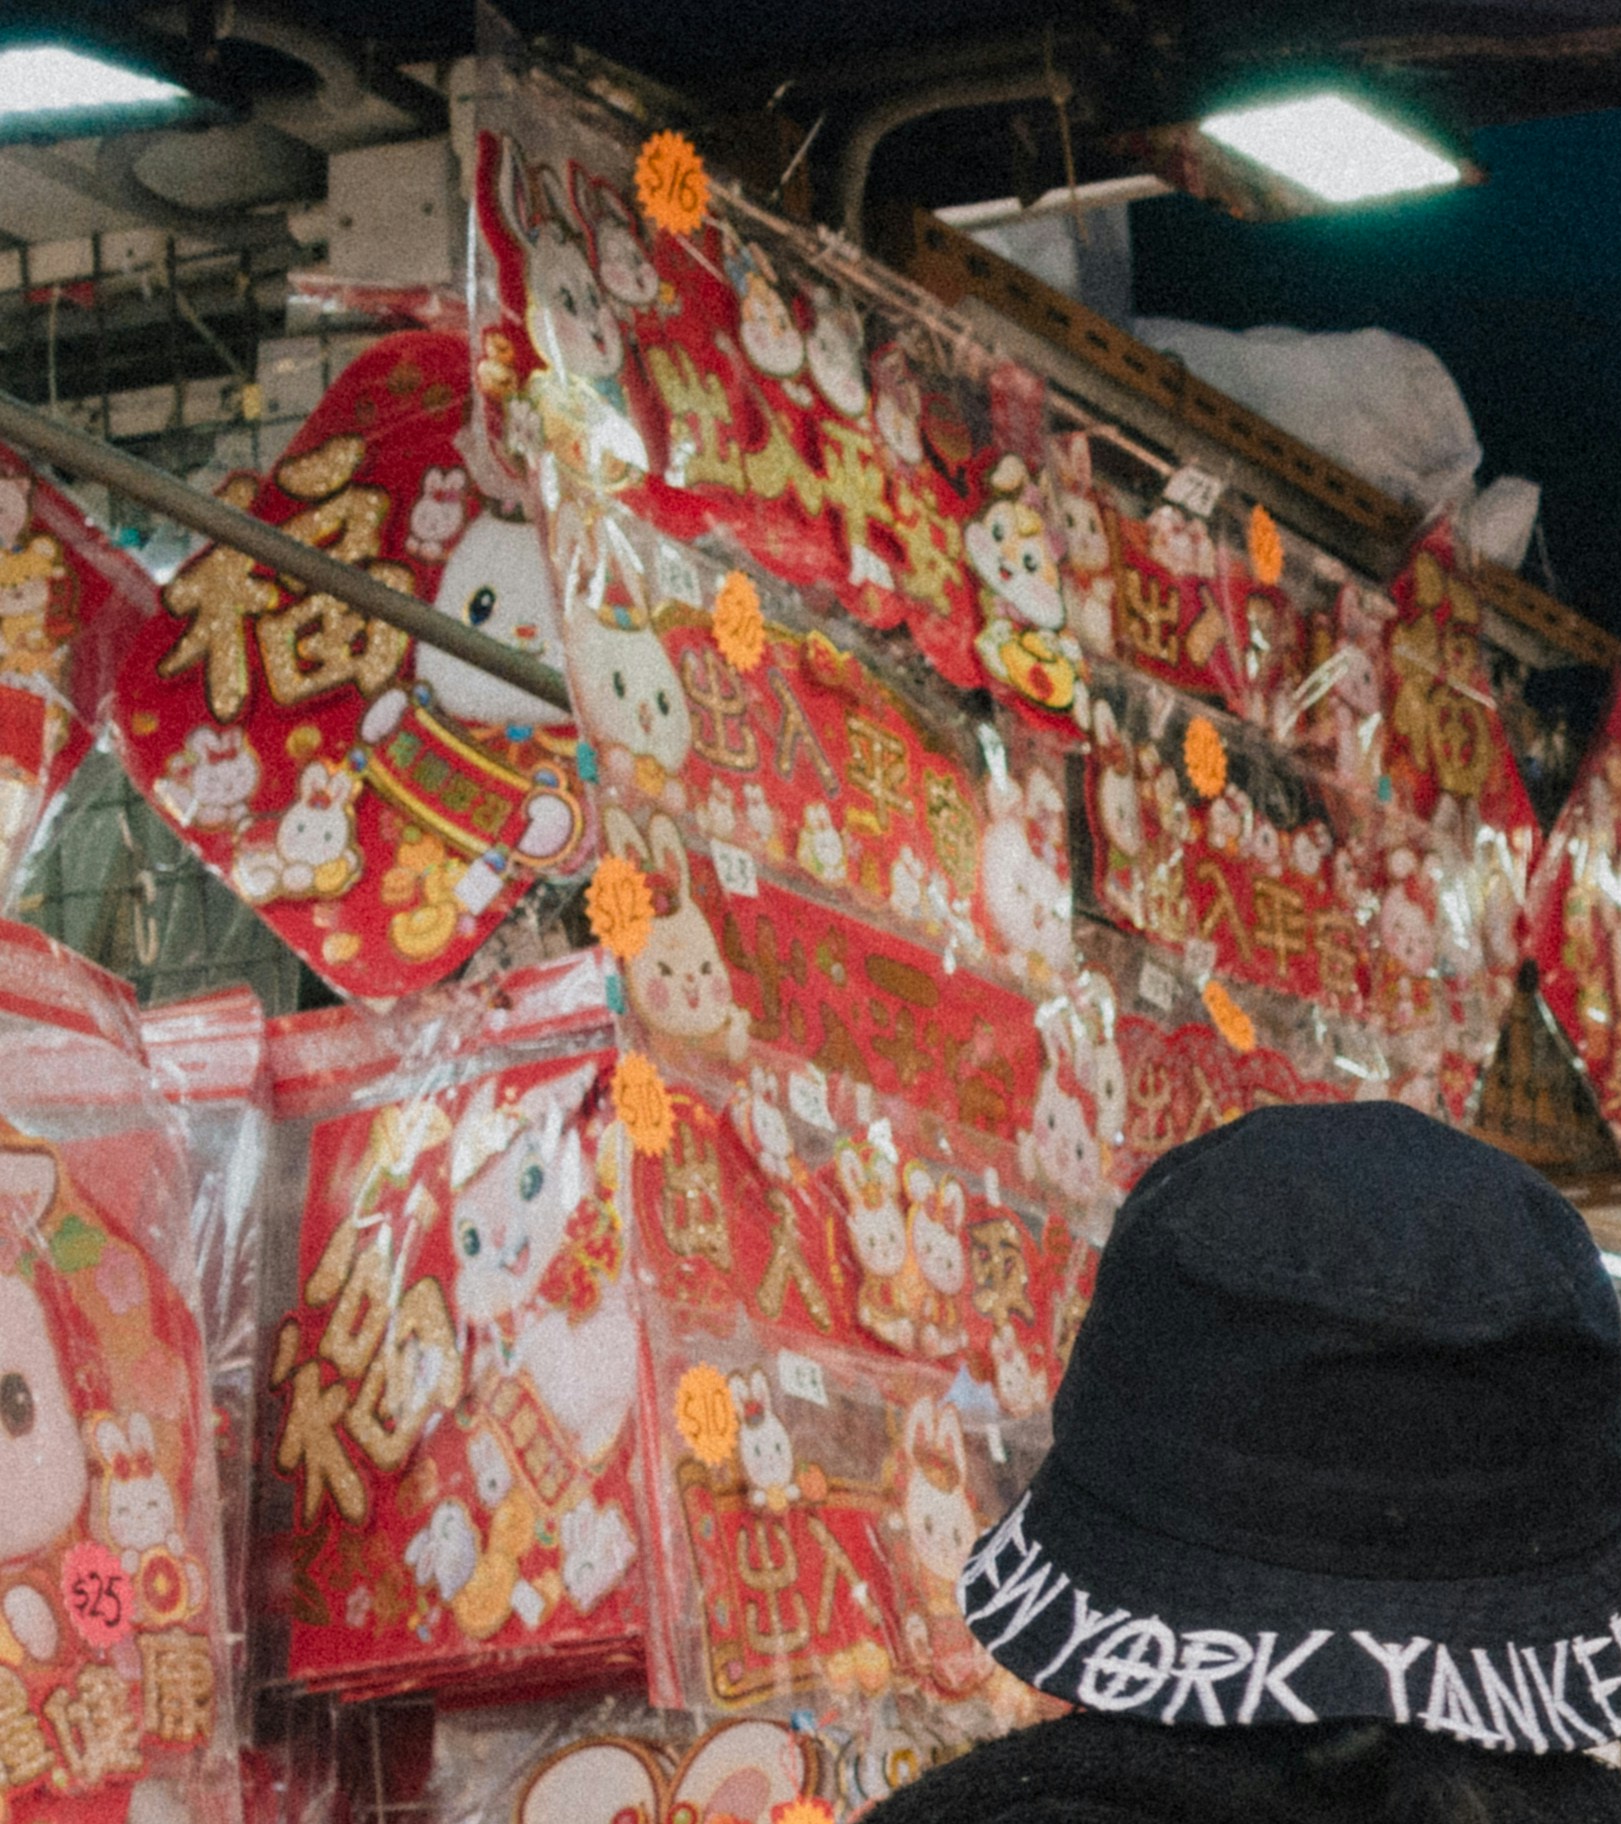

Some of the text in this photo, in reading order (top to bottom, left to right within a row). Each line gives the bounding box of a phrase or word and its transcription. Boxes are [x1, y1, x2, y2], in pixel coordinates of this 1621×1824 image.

[643, 146, 702, 214] $16
[158, 434, 415, 724] 福
[71, 1570, 124, 1630] $25
[955, 1489, 1071, 1656] EW
[1032, 1584, 1335, 1727] YORK
